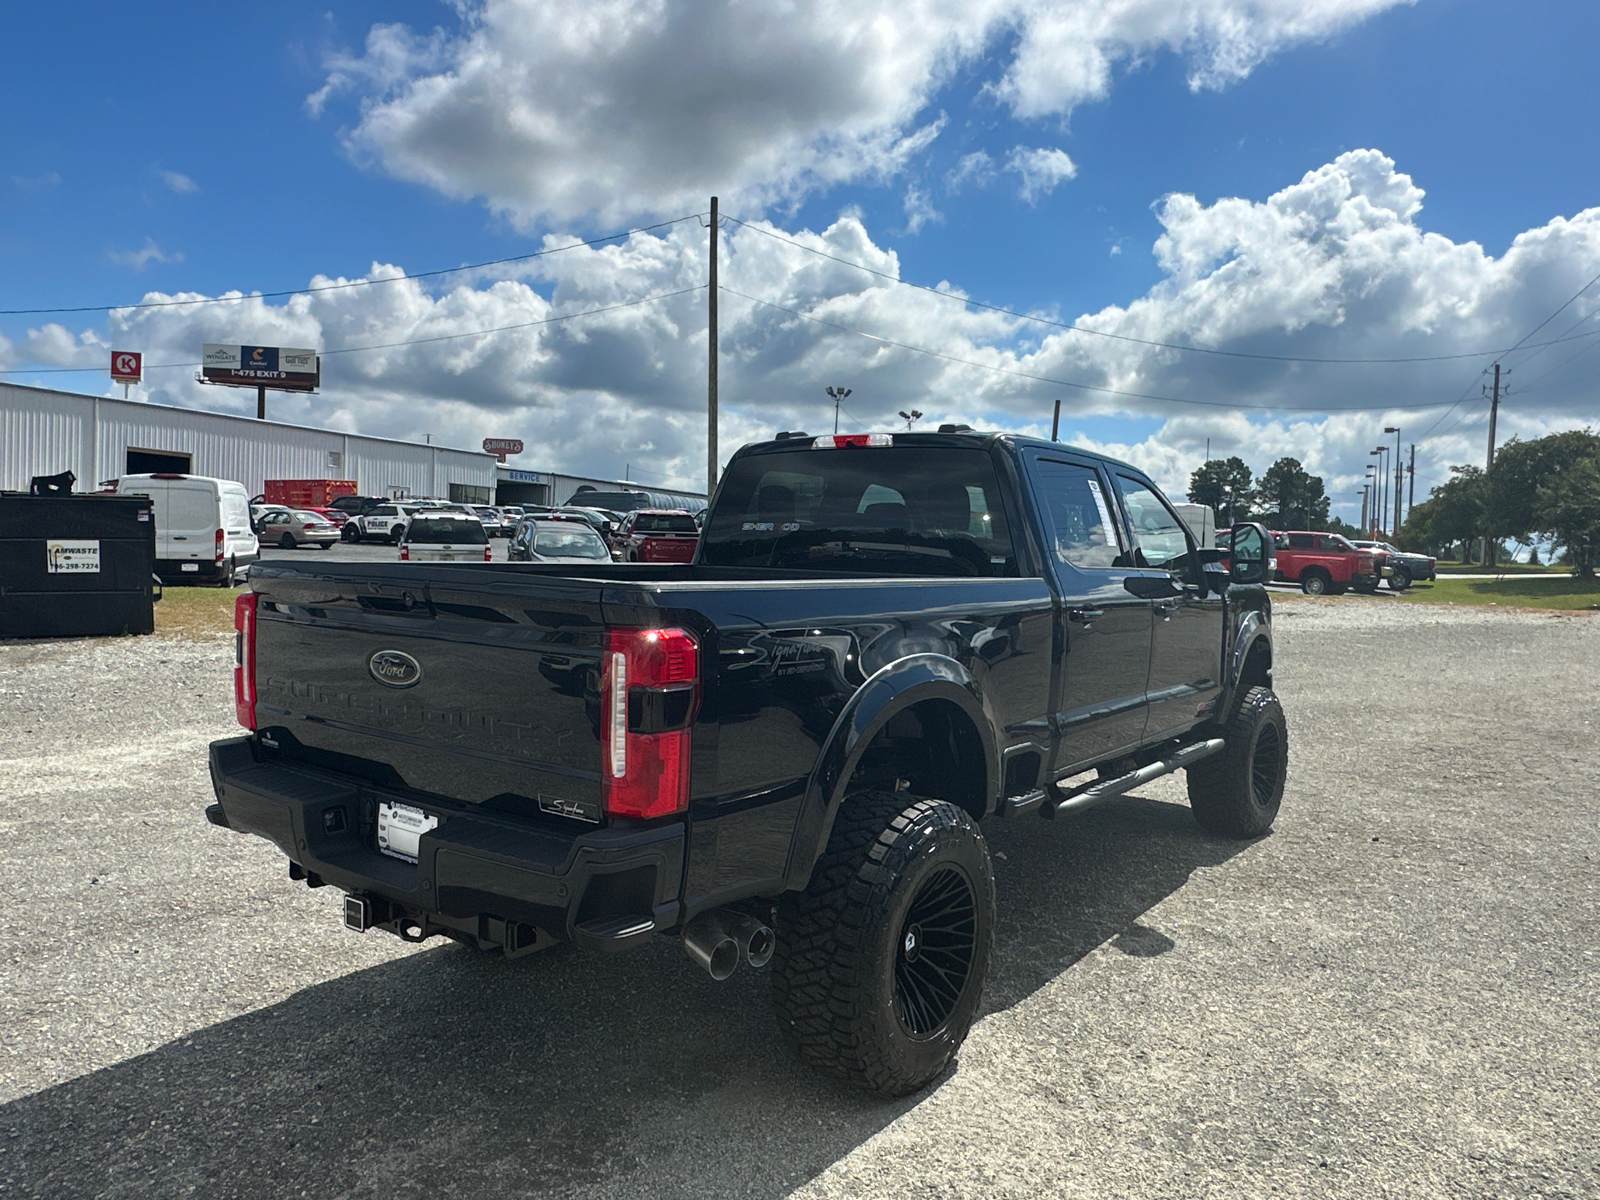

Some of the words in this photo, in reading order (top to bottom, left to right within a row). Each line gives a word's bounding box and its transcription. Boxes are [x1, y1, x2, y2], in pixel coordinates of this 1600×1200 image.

[231, 369, 255, 377] I-475
[280, 371, 287, 379] 9
[484, 440, 521, 452] SHONEY'S
[509, 471, 540, 482] SERVICE
[367, 520, 388, 528] POLICE
[373, 656, 407, 678] Ford
